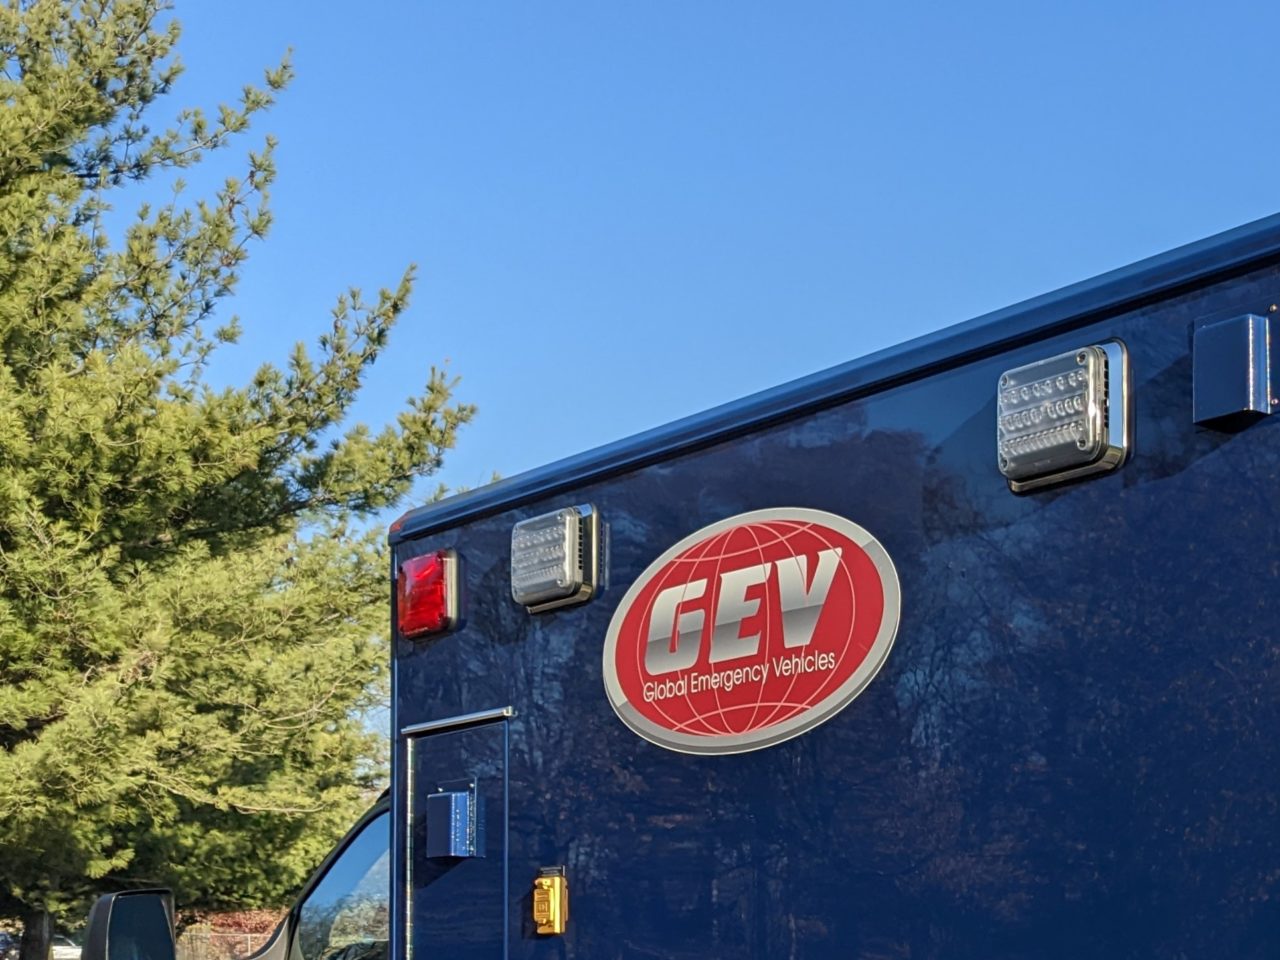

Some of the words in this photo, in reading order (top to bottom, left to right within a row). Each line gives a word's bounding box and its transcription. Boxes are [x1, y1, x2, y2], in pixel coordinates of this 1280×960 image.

[644, 547, 842, 676] GEV
[642, 671, 688, 703] Global
[690, 662, 769, 695] Emergency
[773, 650, 836, 678] Vehicles
